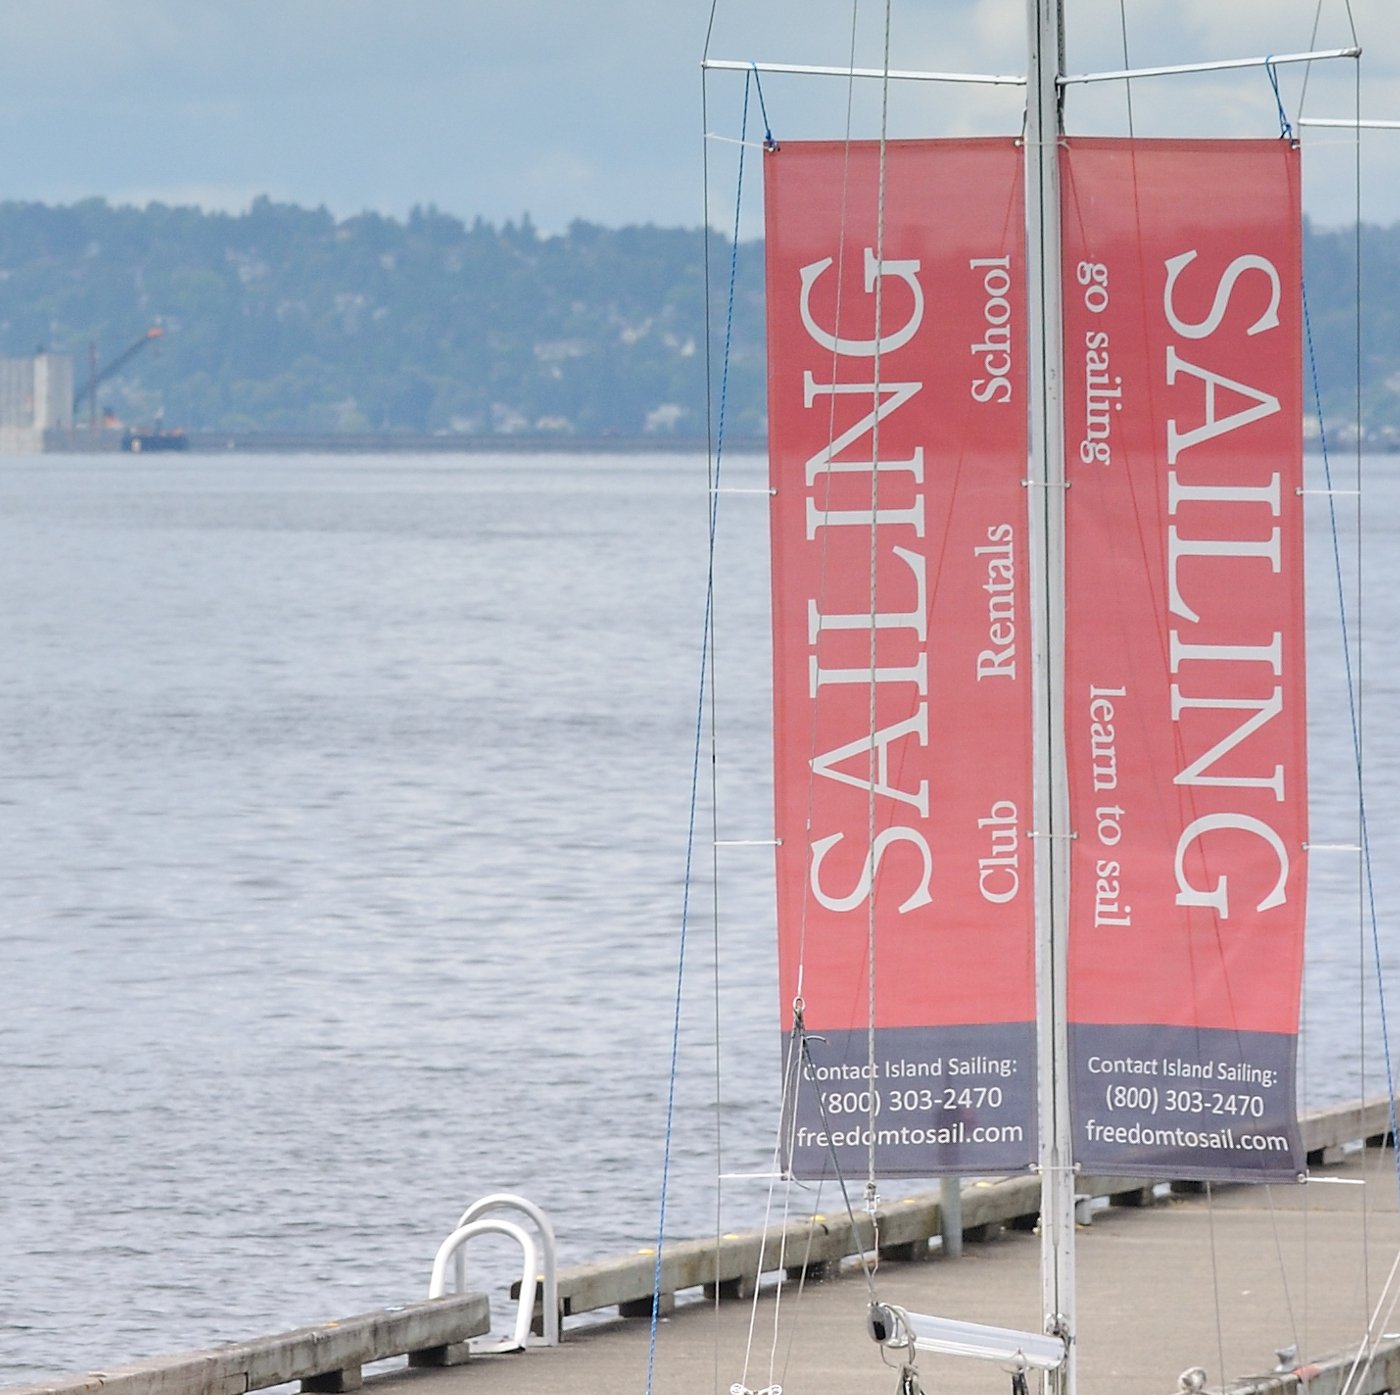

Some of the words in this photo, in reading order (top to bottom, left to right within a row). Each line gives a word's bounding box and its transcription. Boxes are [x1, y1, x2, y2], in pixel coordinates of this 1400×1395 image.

[1077, 261, 1108, 313] go
[970, 254, 1011, 403] School
[1080, 332, 1122, 466] sailing
[799, 248, 933, 914] SAILING
[977, 523, 1015, 682] Rentals
[1164, 249, 1289, 920] SAILING
[1090, 685, 1127, 791] learn
[978, 800, 1019, 903] Club
[1095, 805, 1126, 845] to
[1095, 863, 1131, 928] sail
[886, 1058, 943, 1078] Island
[948, 1056, 1018, 1078] Sailing:
[1088, 1056, 1158, 1076] Contact
[1163, 1058, 1213, 1079] Island
[1217, 1062, 1278, 1087] Sailing:
[889, 1087, 1002, 1111] 303-2470
[1106, 1084, 1158, 1115] (800)
[1165, 1090, 1264, 1117] 303-2470
[797, 1122, 1023, 1147] freedomtosail.com
[1085, 1119, 1289, 1151] freedomtosail.com
